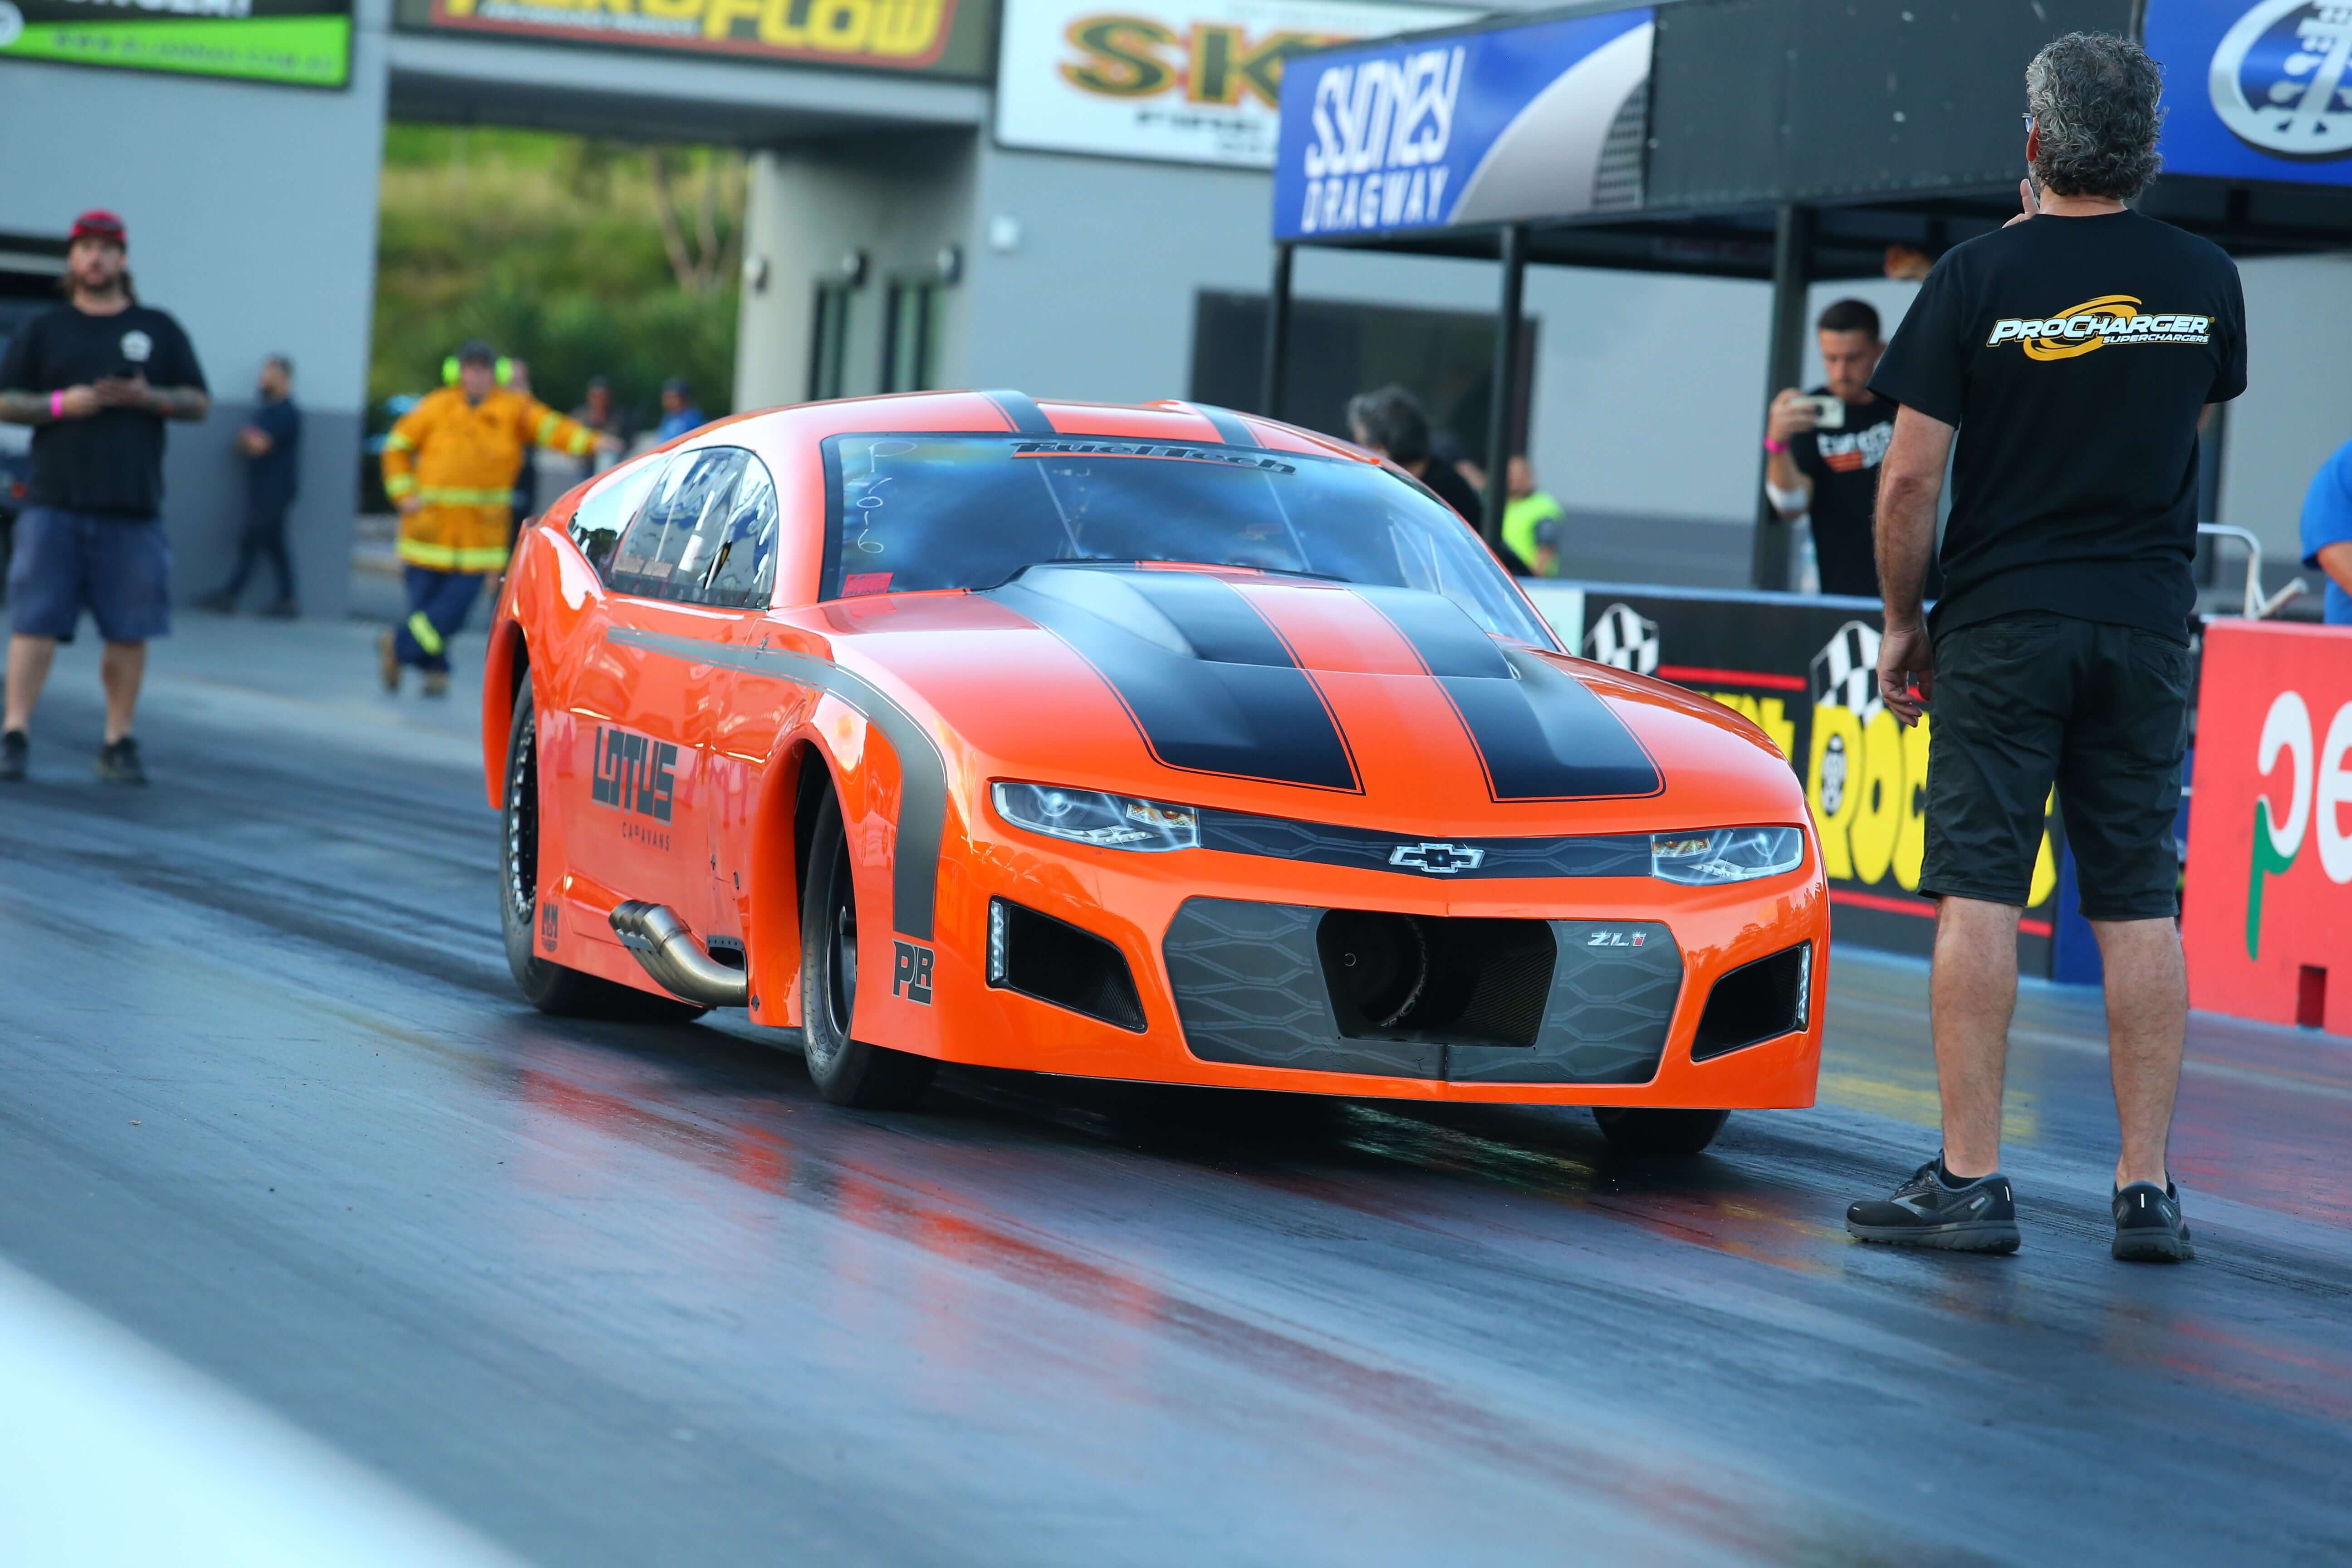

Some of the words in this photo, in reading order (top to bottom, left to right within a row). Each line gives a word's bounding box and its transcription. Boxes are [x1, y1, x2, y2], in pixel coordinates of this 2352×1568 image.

[1301, 164, 1449, 234] DRAGWAY
[2102, 333, 2209, 344] SUPERCHARGERS
[592, 725, 678, 827] LOTUS
[1588, 930, 1647, 946] ZL1
